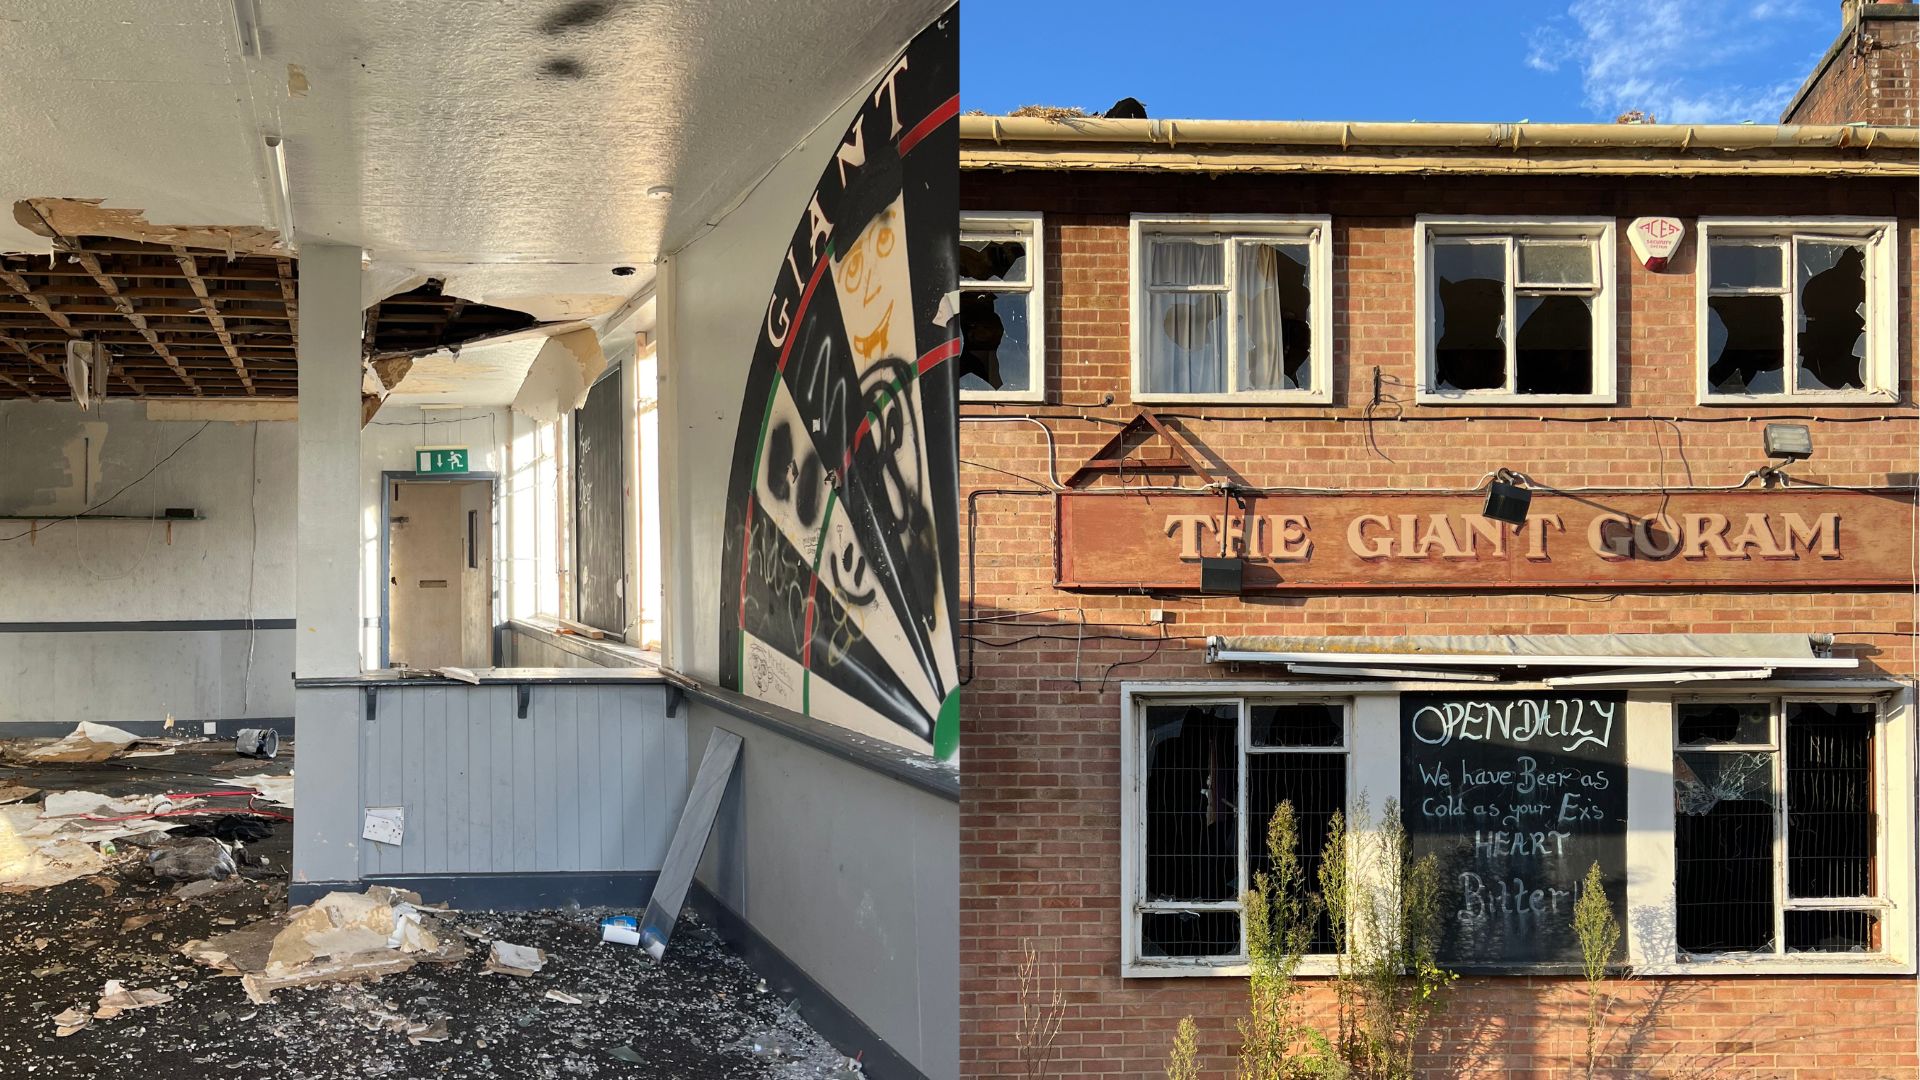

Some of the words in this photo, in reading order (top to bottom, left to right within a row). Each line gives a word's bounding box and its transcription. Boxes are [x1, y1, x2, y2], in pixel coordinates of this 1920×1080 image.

[767, 55, 908, 348] GIANT
[1164, 514, 1313, 562] THE
[1347, 513, 1565, 562] GIANT
[1588, 512, 1844, 562] GORAM
[1419, 760, 1451, 787] We
[1462, 759, 1513, 787] have
[1516, 756, 1573, 793] Beer
[1580, 770, 1609, 790] as
[1422, 796, 1465, 817] Cold
[1473, 802, 1500, 817] as
[1503, 801, 1552, 826] your
[1474, 829, 1571, 858] HEART
